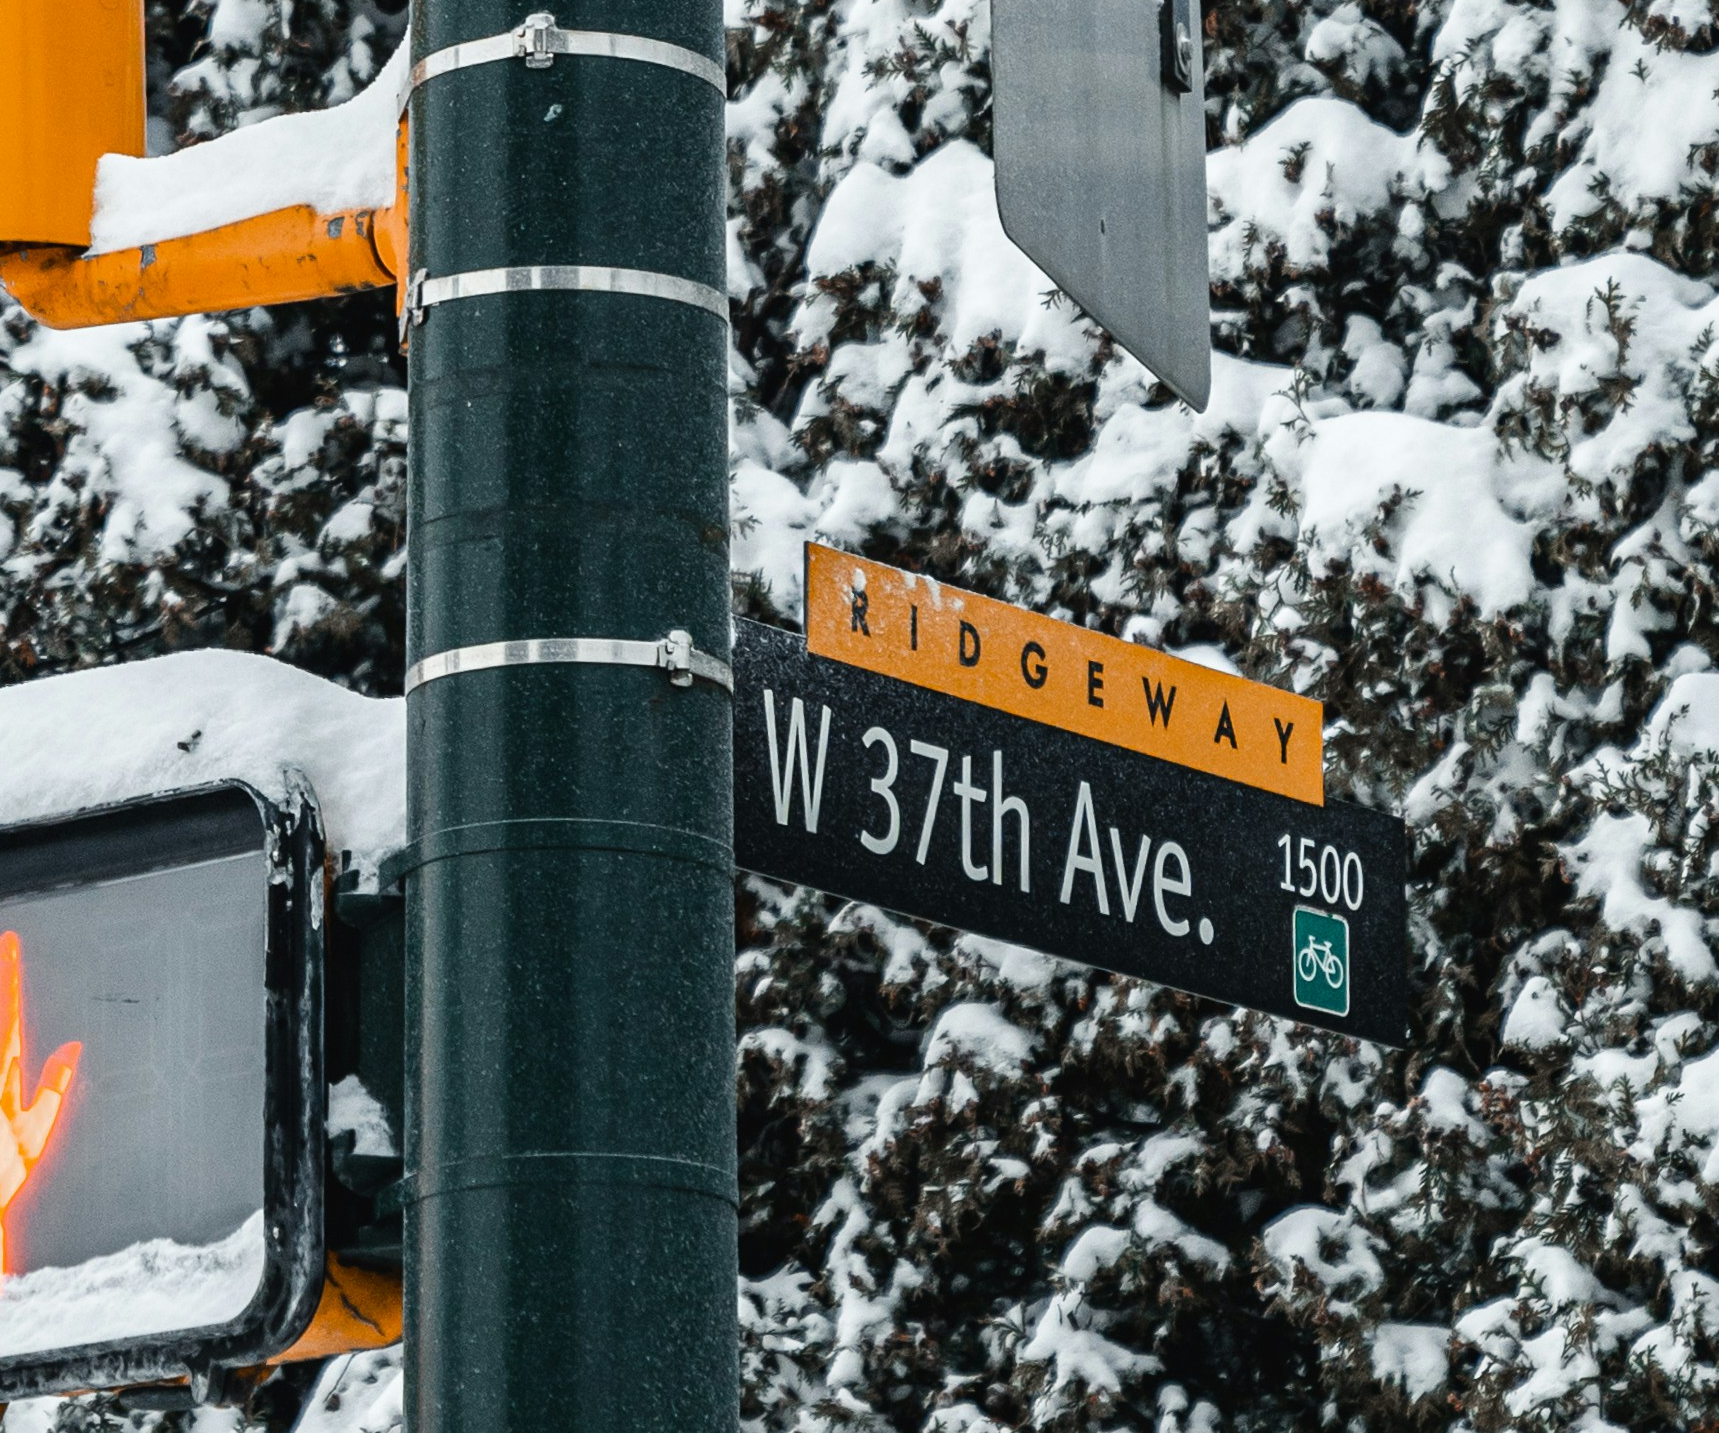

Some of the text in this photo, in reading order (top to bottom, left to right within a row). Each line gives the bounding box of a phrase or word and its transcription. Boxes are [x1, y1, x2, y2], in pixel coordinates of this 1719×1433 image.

[850, 587, 1295, 765] RIDGEWAY
[763, 688, 1215, 946] W 37th Ave.
[1277, 833, 1364, 912] 1500
